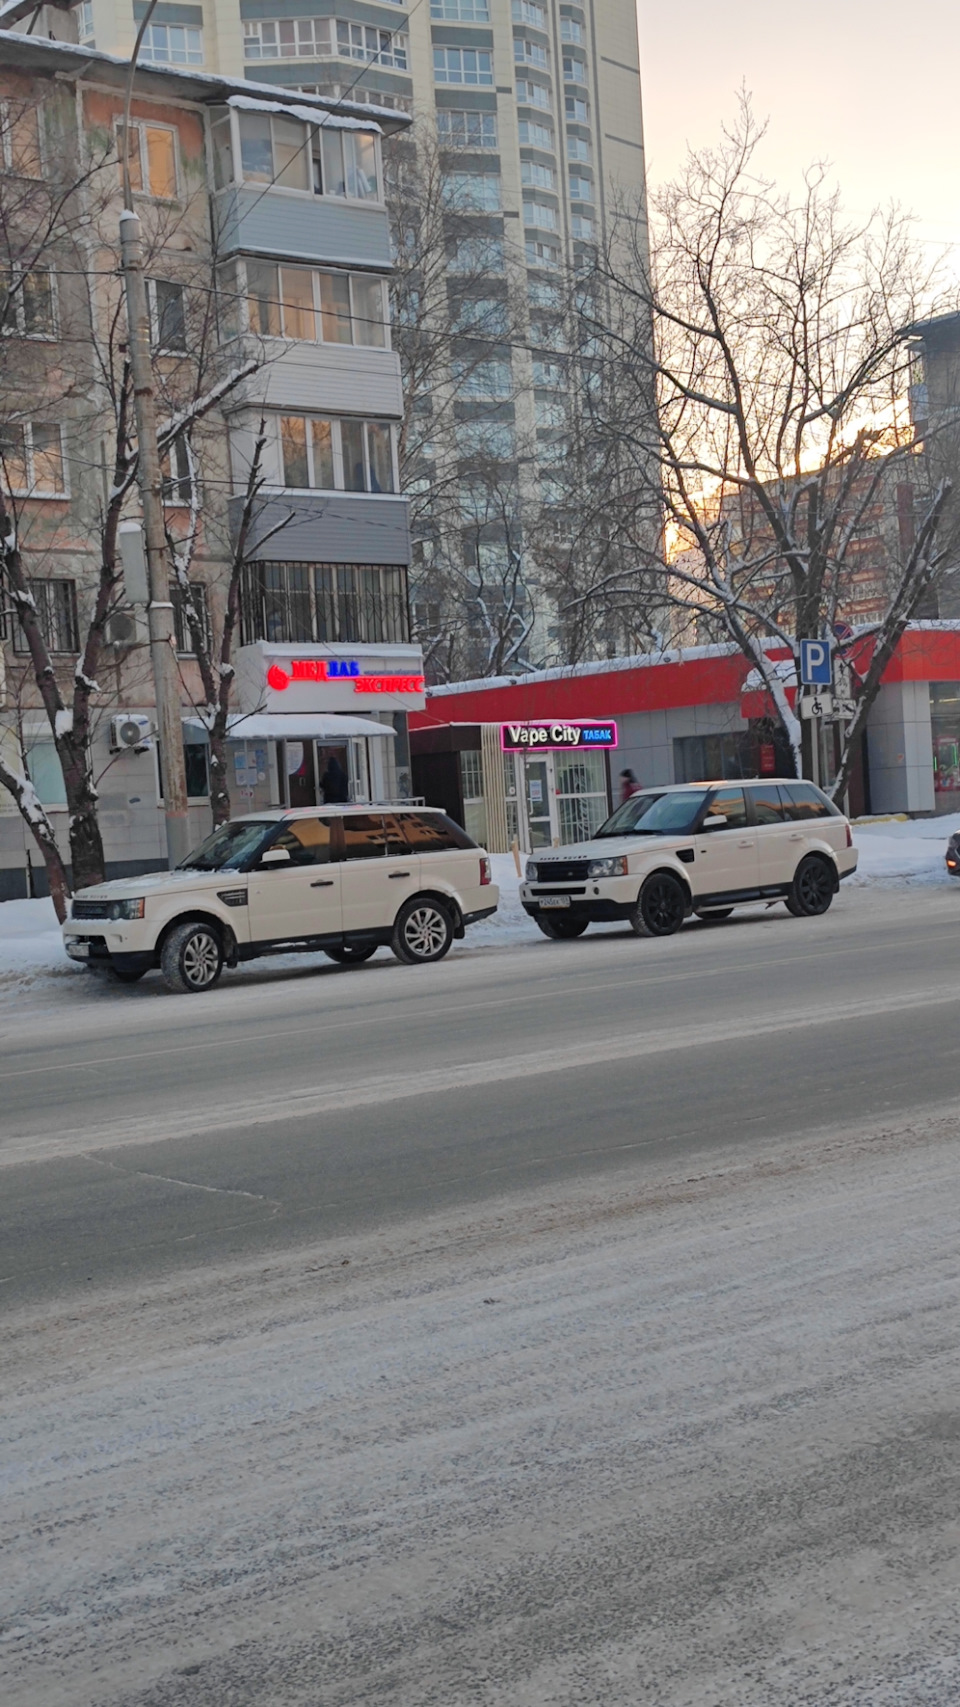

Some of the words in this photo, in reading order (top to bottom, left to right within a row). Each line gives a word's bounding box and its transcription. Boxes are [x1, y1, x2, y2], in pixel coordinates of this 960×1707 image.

[806, 642, 825, 681] P
[354, 677, 424, 693] ЭКСПРЕСС
[509, 725, 548, 746] Vape
[551, 724, 581, 745] City
[583, 729, 612, 741] ТАБАК
